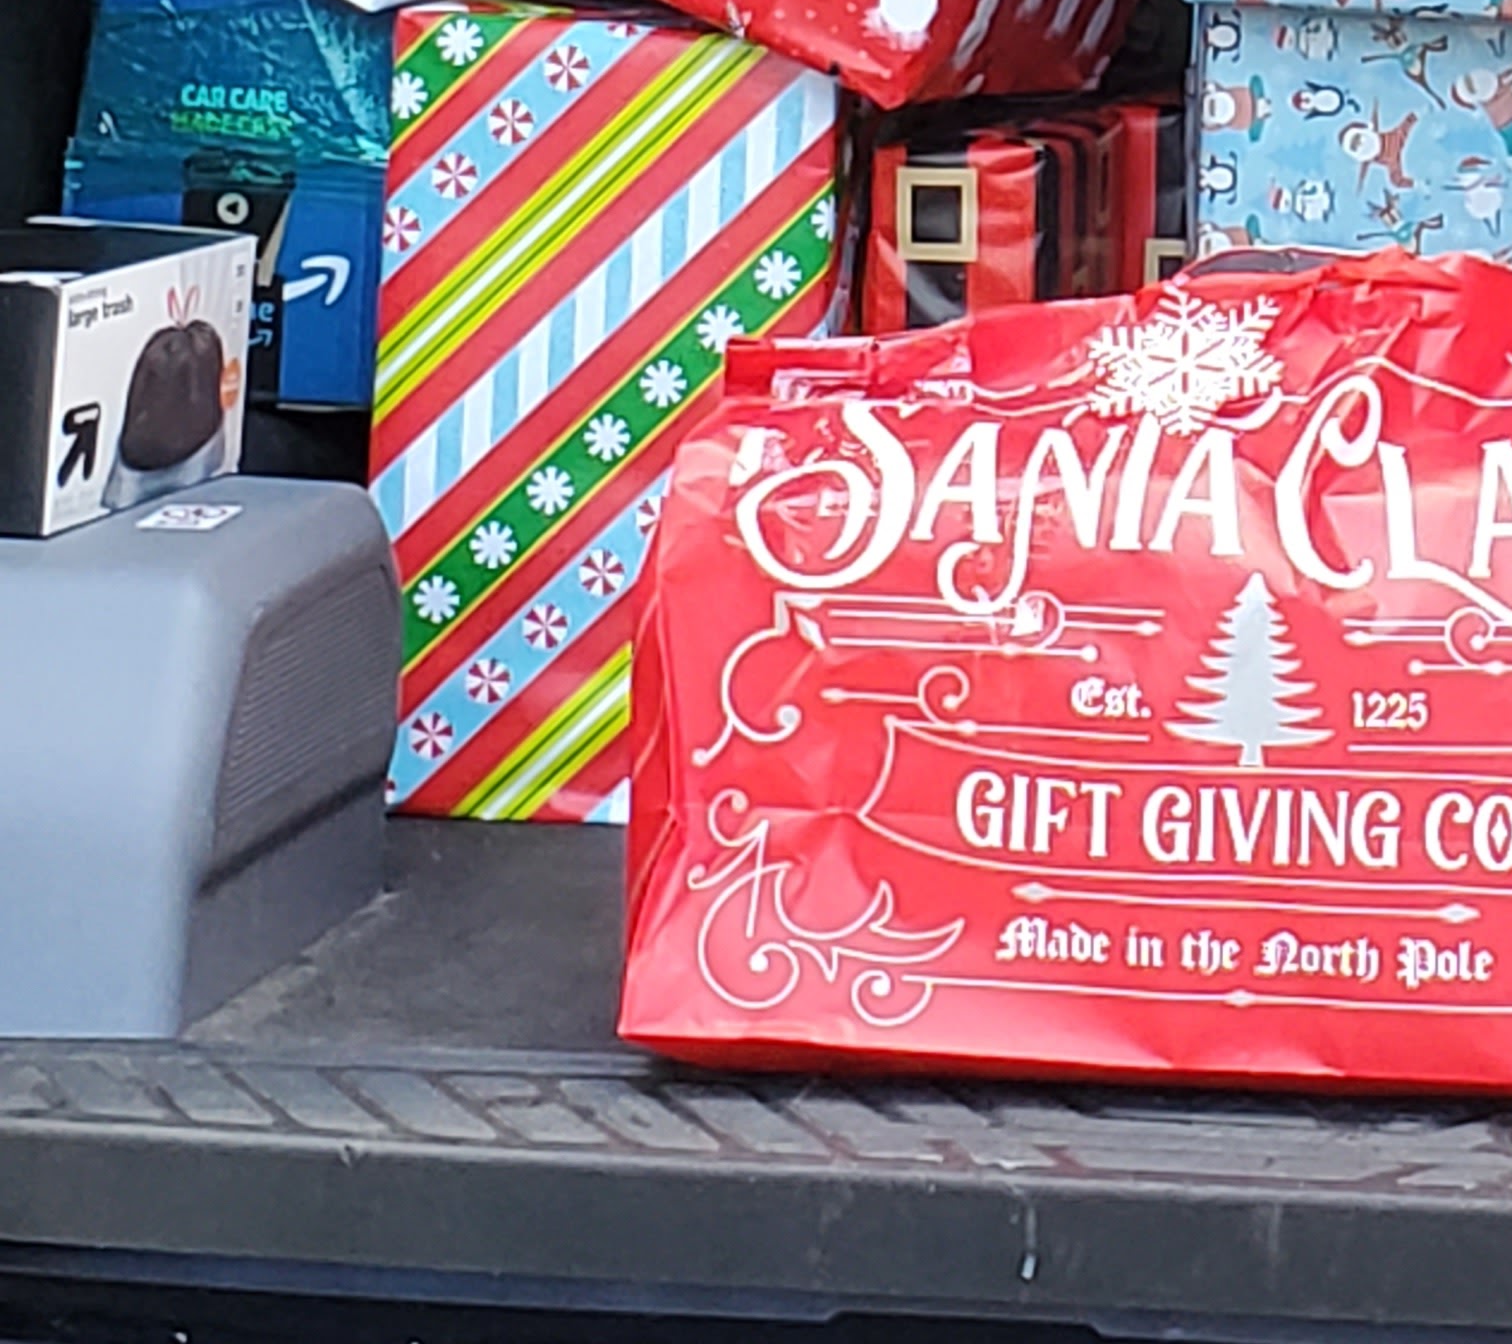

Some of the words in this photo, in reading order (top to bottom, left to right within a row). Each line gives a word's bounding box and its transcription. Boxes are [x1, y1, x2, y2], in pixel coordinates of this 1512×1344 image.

[181, 83, 225, 109] CAR
[230, 87, 288, 112] CARE
[1071, 677, 1152, 718] Est.
[1351, 690, 1429, 729] 1225
[956, 770, 1121, 858] GIFT
[1141, 784, 1401, 869] GIVING
[996, 914, 1111, 963] Made
[1126, 924, 1164, 968] in
[1180, 927, 1241, 975] the
[1253, 930, 1380, 984] North
[1395, 936, 1495, 988] Pole
